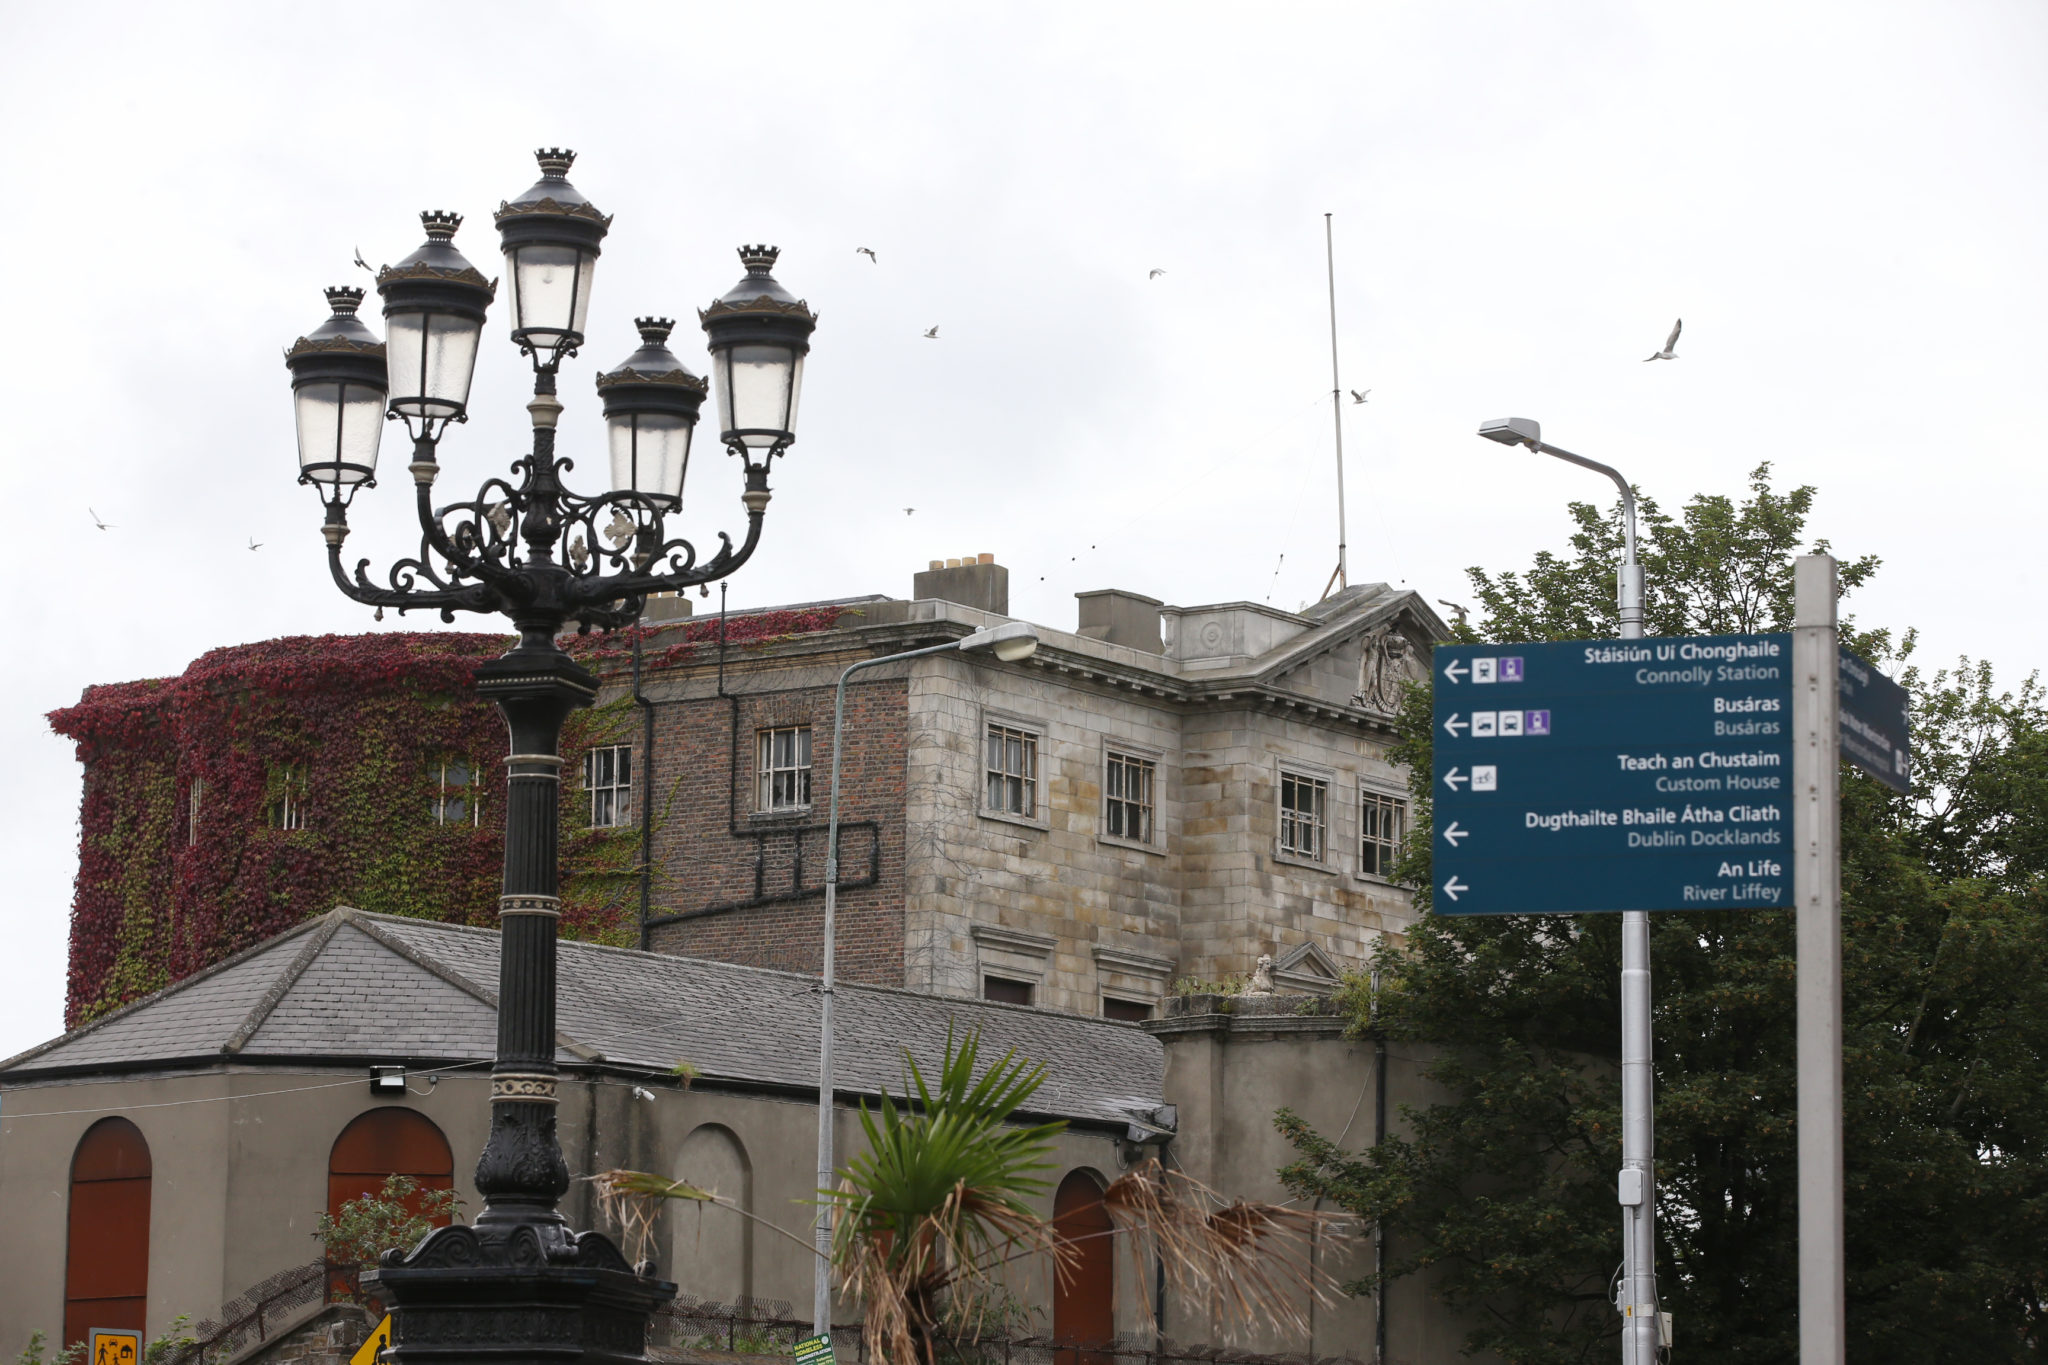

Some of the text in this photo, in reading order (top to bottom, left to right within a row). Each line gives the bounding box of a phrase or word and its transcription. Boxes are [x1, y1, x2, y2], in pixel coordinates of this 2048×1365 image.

[1584, 646, 1652, 664] Stáisiún
[1680, 640, 1780, 662] Chonghaile
[1636, 664, 1780, 685] Connolly Station
[1714, 696, 1780, 714] Busáras
[1714, 718, 1780, 737] Busáras
[1617, 750, 1780, 770] Teach an Chustaim
[1655, 775, 1780, 792] Custom House
[1525, 803, 1780, 831] Dugthailte Bhaile Átha Cliath
[1628, 828, 1781, 847] Dublin Docklands
[1717, 859, 1781, 877] An Life
[1683, 882, 1782, 903] River Liffey
[794, 1338, 821, 1351] NATIONAL
